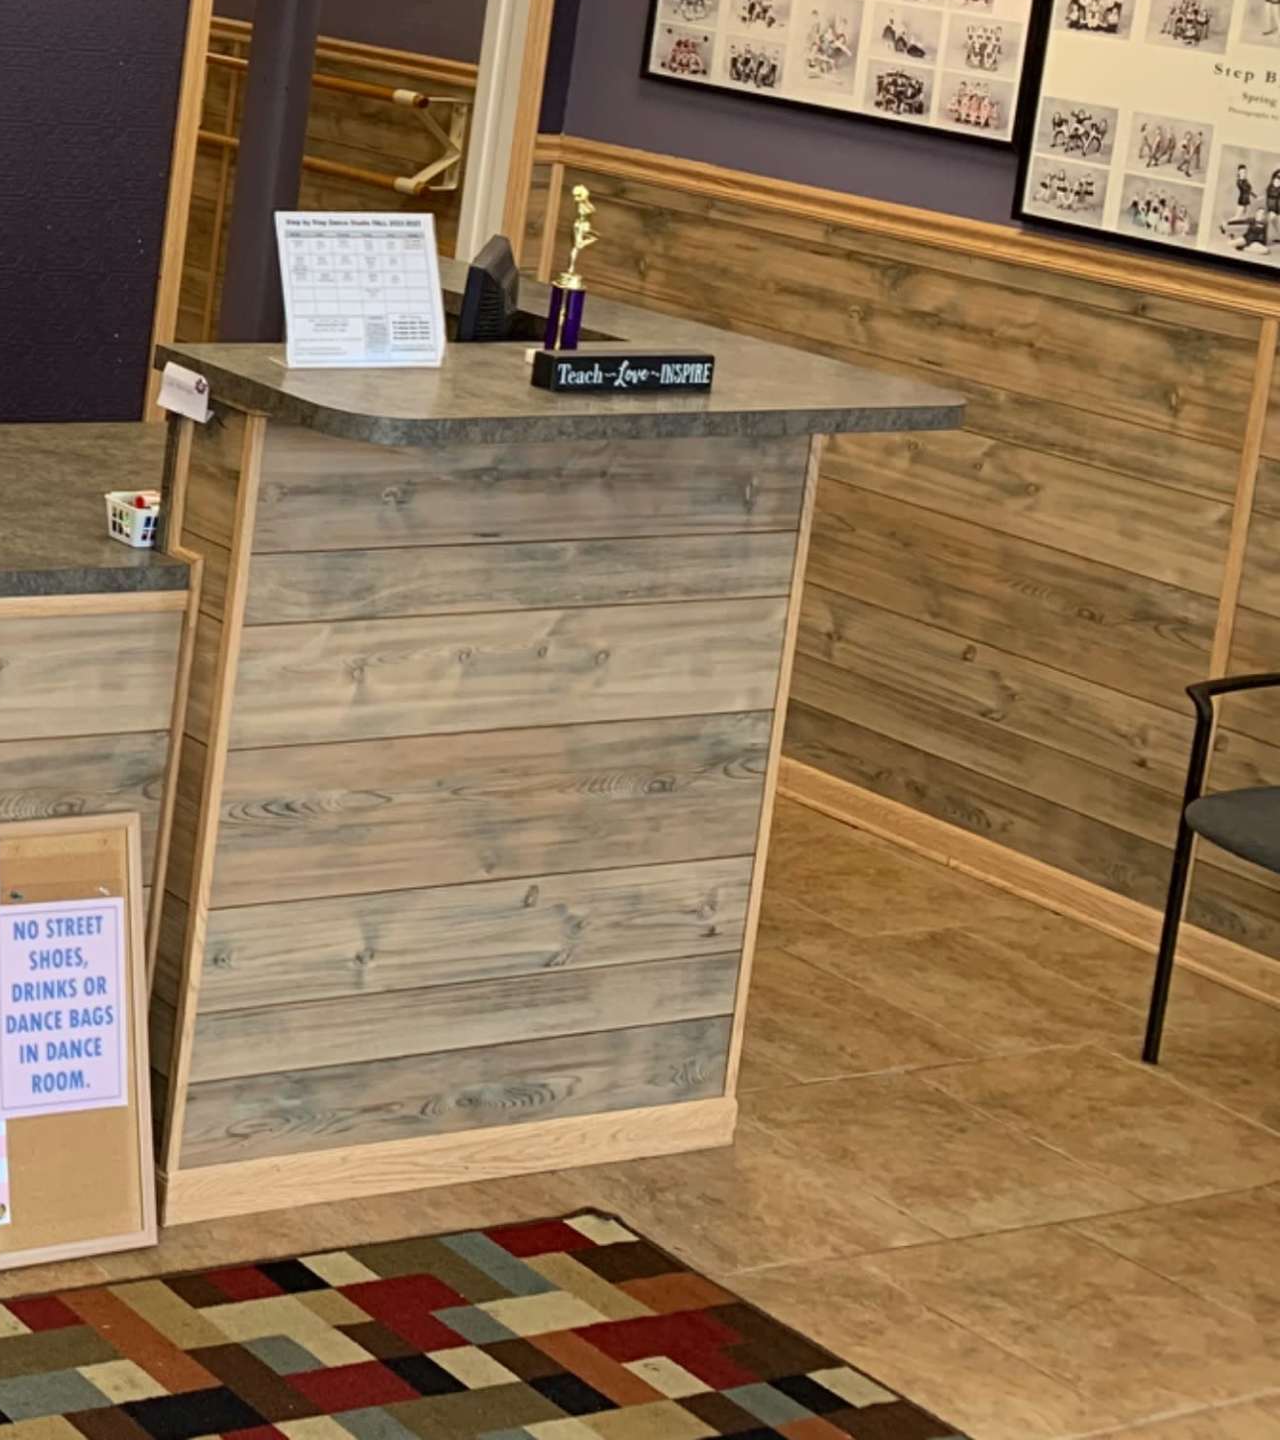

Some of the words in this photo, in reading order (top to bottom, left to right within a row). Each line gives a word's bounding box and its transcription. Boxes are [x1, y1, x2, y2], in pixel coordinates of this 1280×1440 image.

[1214, 63, 1255, 83] Step
[1265, 70, 1280, 88] B
[13, 920, 39, 941] NO
[45, 915, 103, 939] STREET
[29, 947, 89, 971] SHOES,
[11, 978, 77, 1003] DRINKS
[83, 976, 107, 996] OR
[5, 1011, 63, 1034] DANCE
[69, 1005, 114, 1029] BAGS
[19, 1044, 39, 1064] IN
[46, 1037, 103, 1062] DANCE
[31, 1070, 90, 1093] ROOM.
